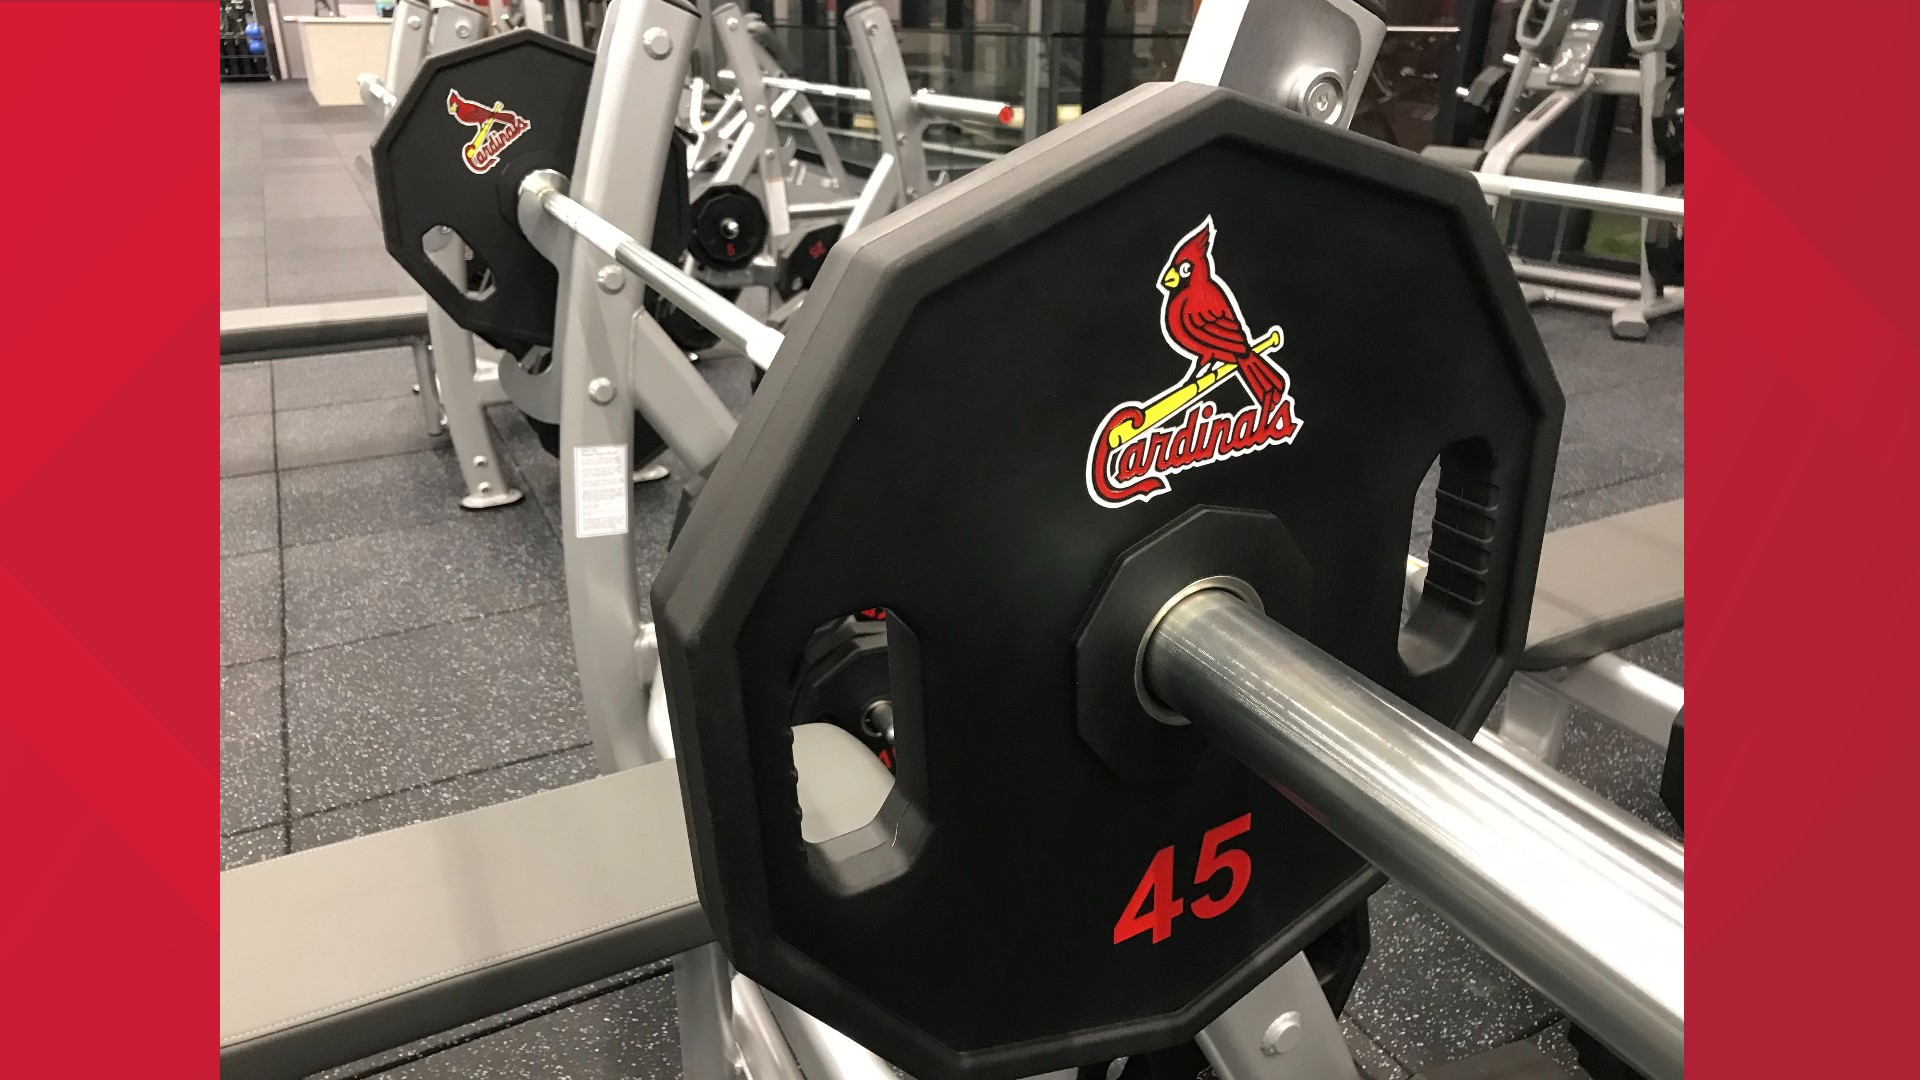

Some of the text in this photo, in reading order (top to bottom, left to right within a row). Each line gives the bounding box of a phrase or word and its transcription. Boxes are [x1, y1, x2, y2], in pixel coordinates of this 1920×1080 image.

[462, 116, 531, 174] Cardinals
[1087, 391, 1303, 508] Cardinals
[1113, 812, 1252, 945] 45
